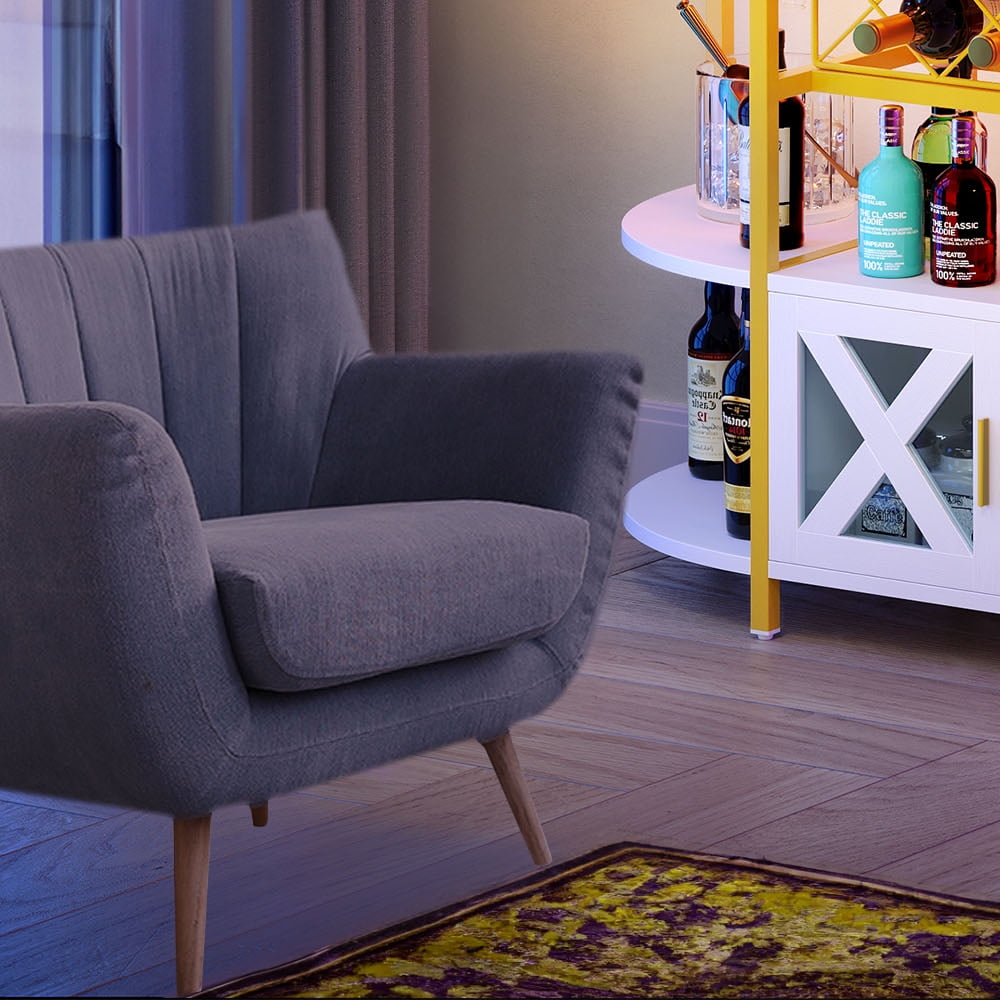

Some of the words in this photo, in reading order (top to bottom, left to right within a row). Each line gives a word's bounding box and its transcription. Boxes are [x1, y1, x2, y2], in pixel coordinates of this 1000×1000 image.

[860, 215, 884, 226] LADDIE
[871, 211, 908, 220] CLASSIC
[932, 226, 956, 237] LADDIE
[944, 222, 979, 230] CLASSIC
[863, 260, 883, 272] 100%
[935, 269, 955, 281] 100%
